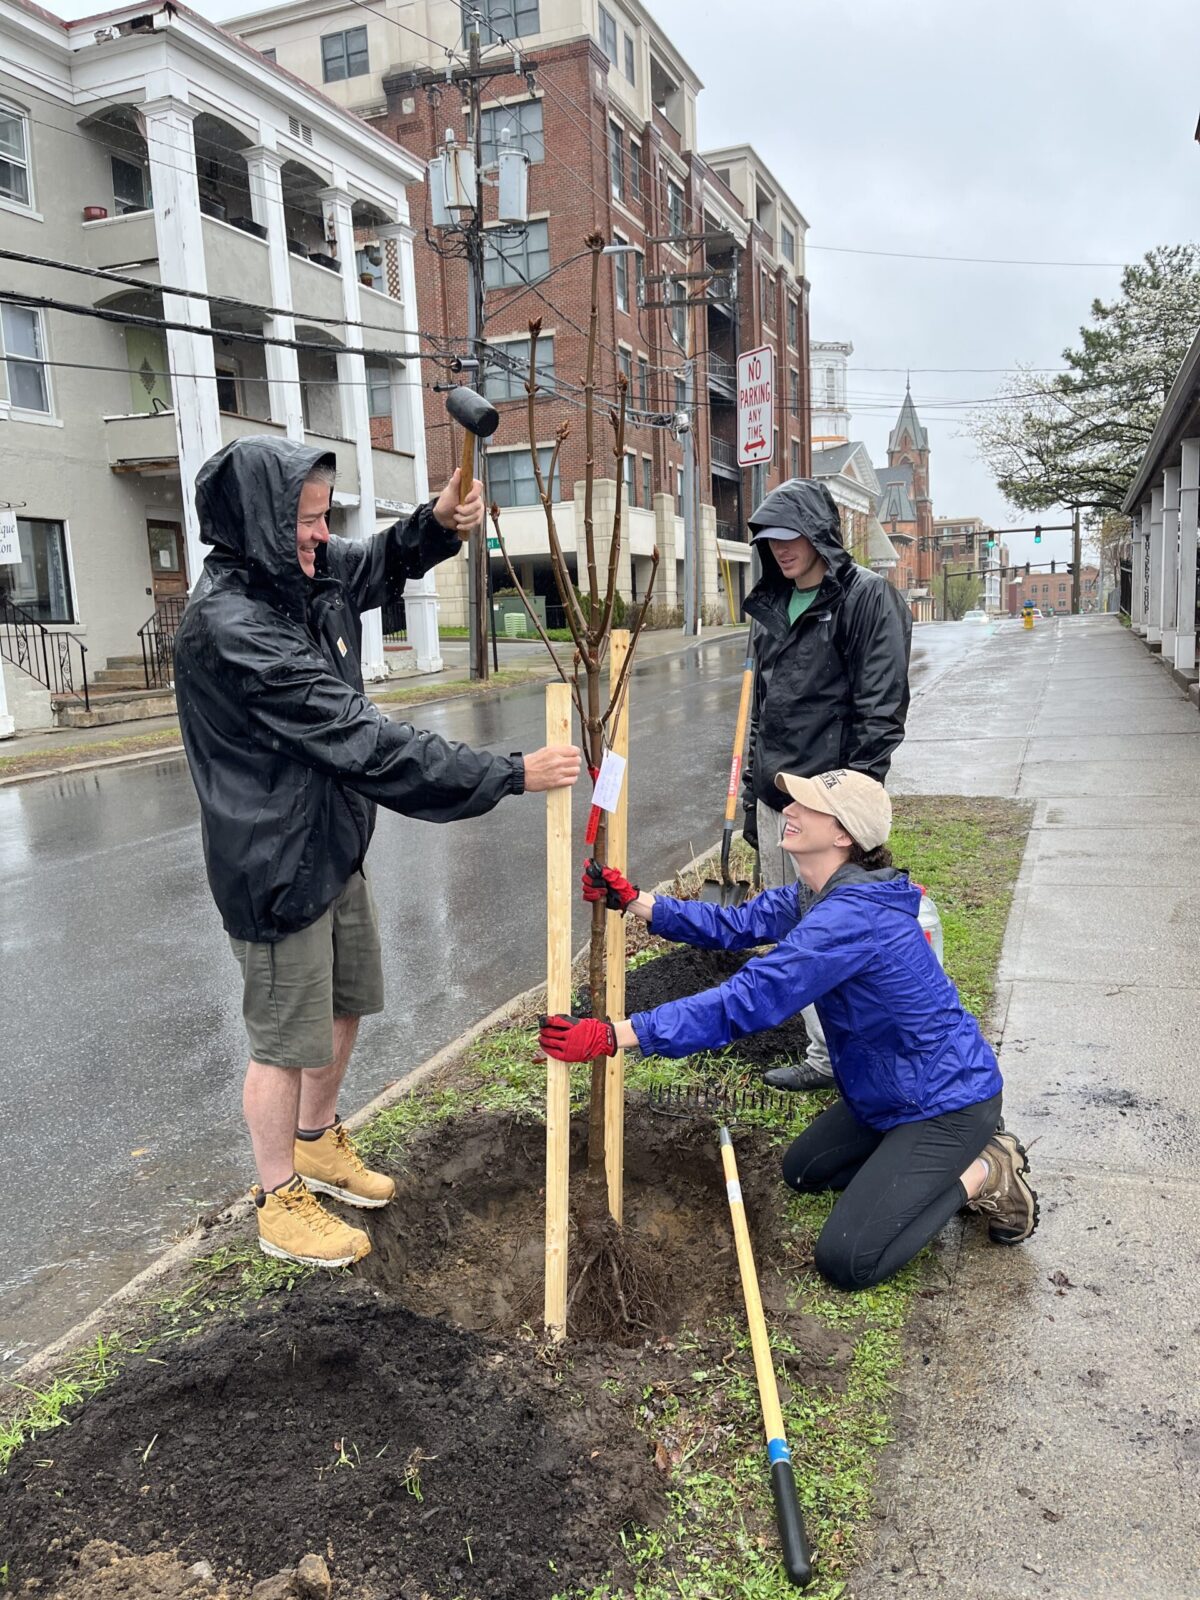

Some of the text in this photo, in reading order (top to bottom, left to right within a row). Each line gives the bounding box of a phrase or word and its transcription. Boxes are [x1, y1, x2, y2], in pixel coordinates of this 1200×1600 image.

[748, 360, 762, 383] NO
[740, 383, 771, 410] PARKING
[748, 408, 762, 423] ANY
[747, 425, 763, 441] TIME
[0, 523, 15, 538] que
